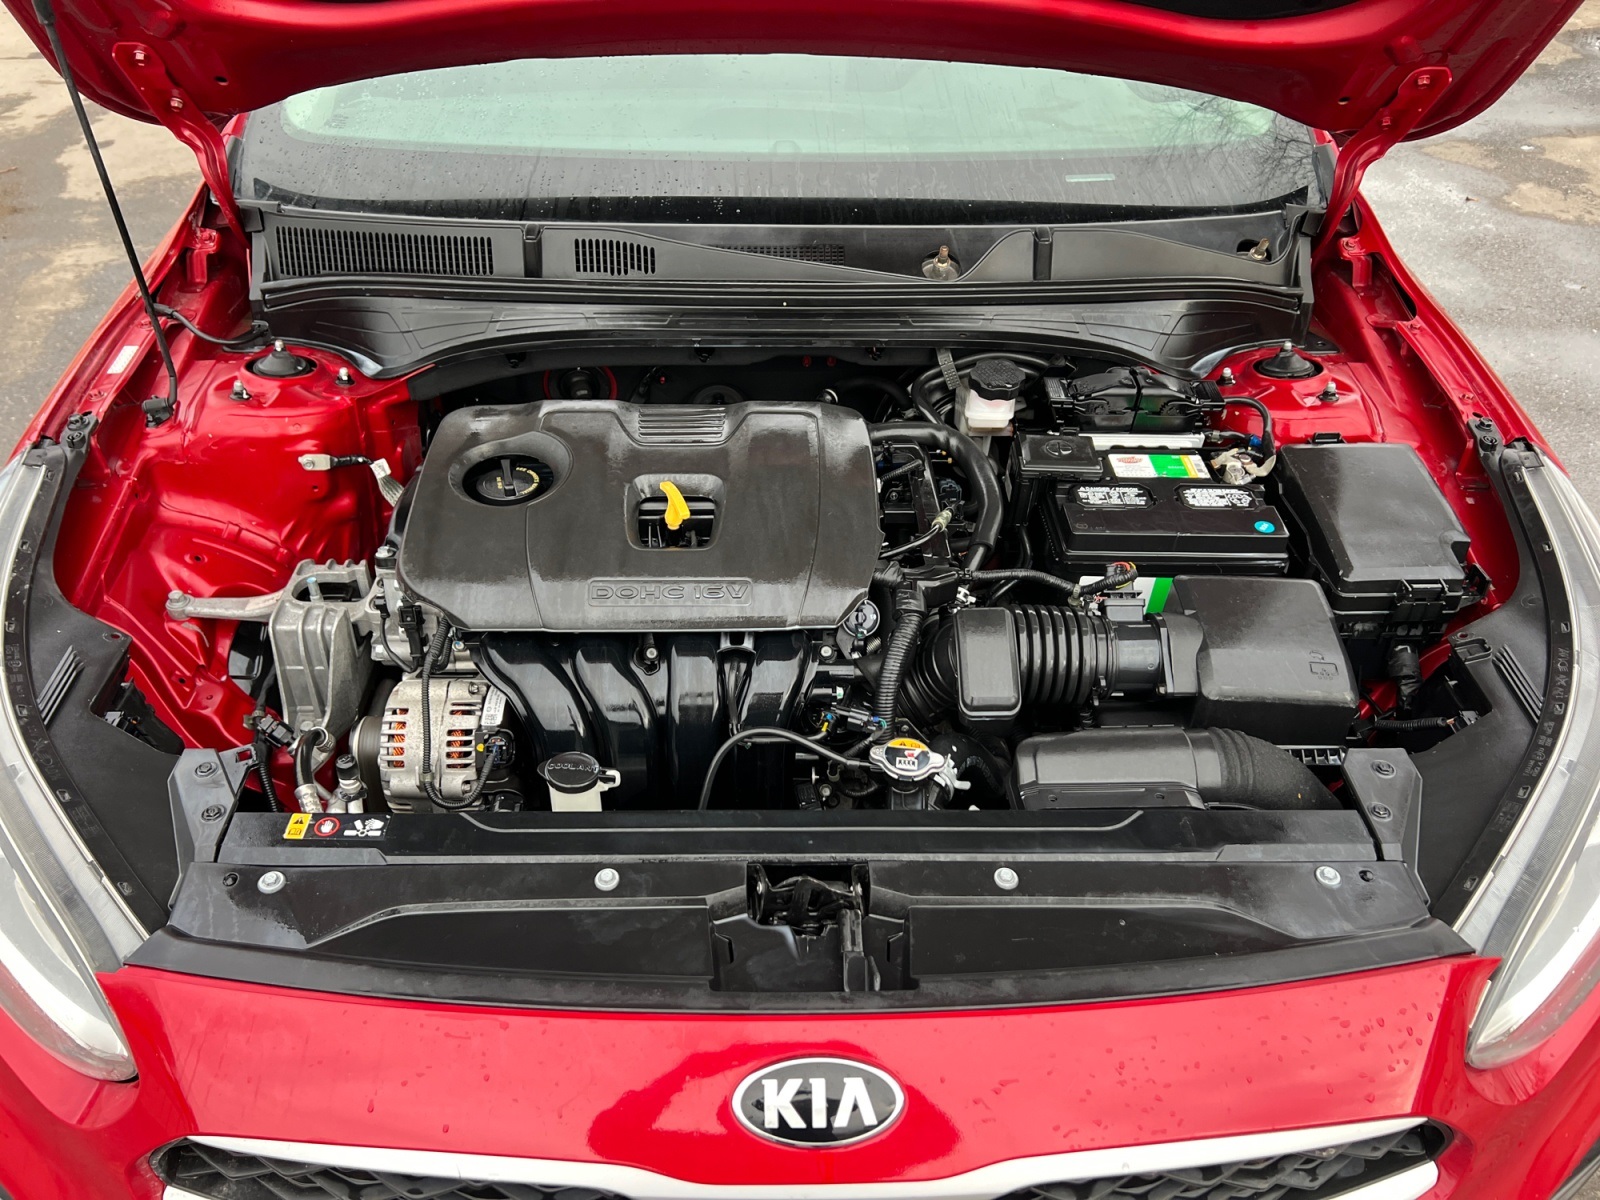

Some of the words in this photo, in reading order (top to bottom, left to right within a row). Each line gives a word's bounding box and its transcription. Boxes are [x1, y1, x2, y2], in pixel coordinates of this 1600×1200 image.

[591, 585, 685, 600] DOHC
[694, 584, 749, 600] 16V
[547, 763, 599, 774] COOLANT
[761, 1077, 878, 1129] KIA
